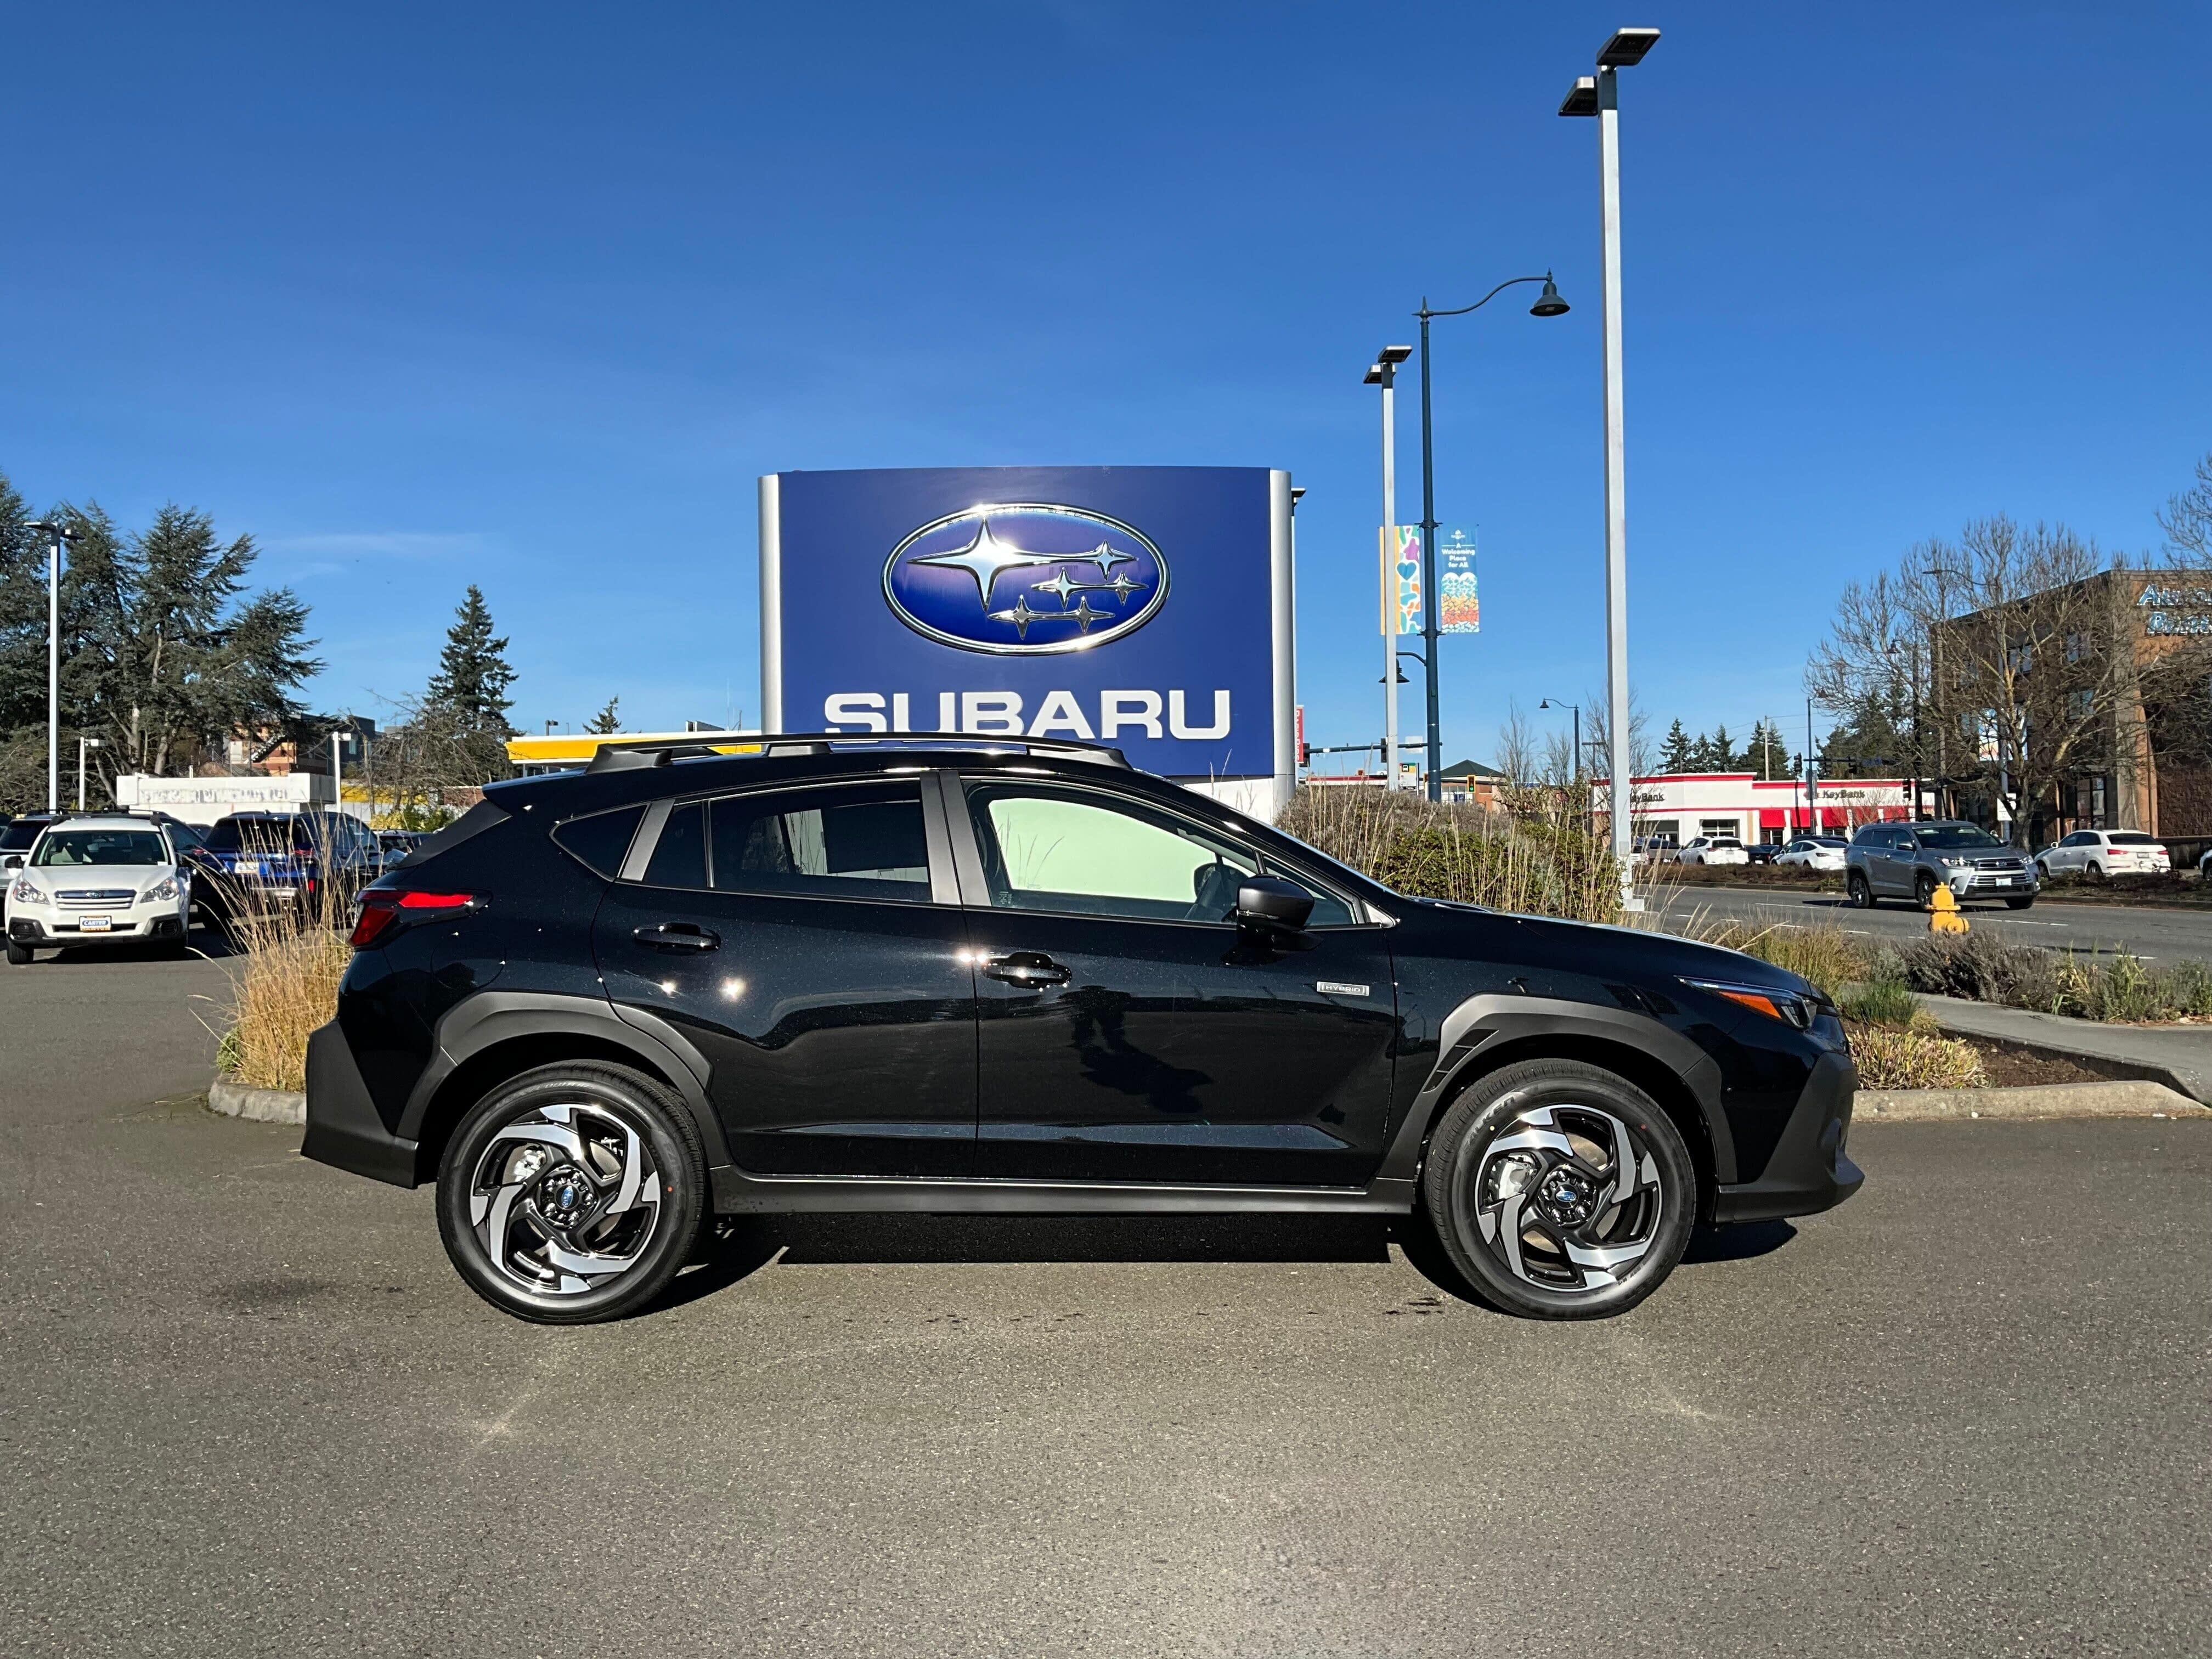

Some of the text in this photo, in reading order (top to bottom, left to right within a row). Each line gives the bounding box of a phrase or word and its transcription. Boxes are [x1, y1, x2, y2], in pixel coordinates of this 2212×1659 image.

[825, 690, 1230, 740] SUBARU
[1630, 793, 1664, 804] eyBank
[1823, 789, 1865, 800] KeyBank
